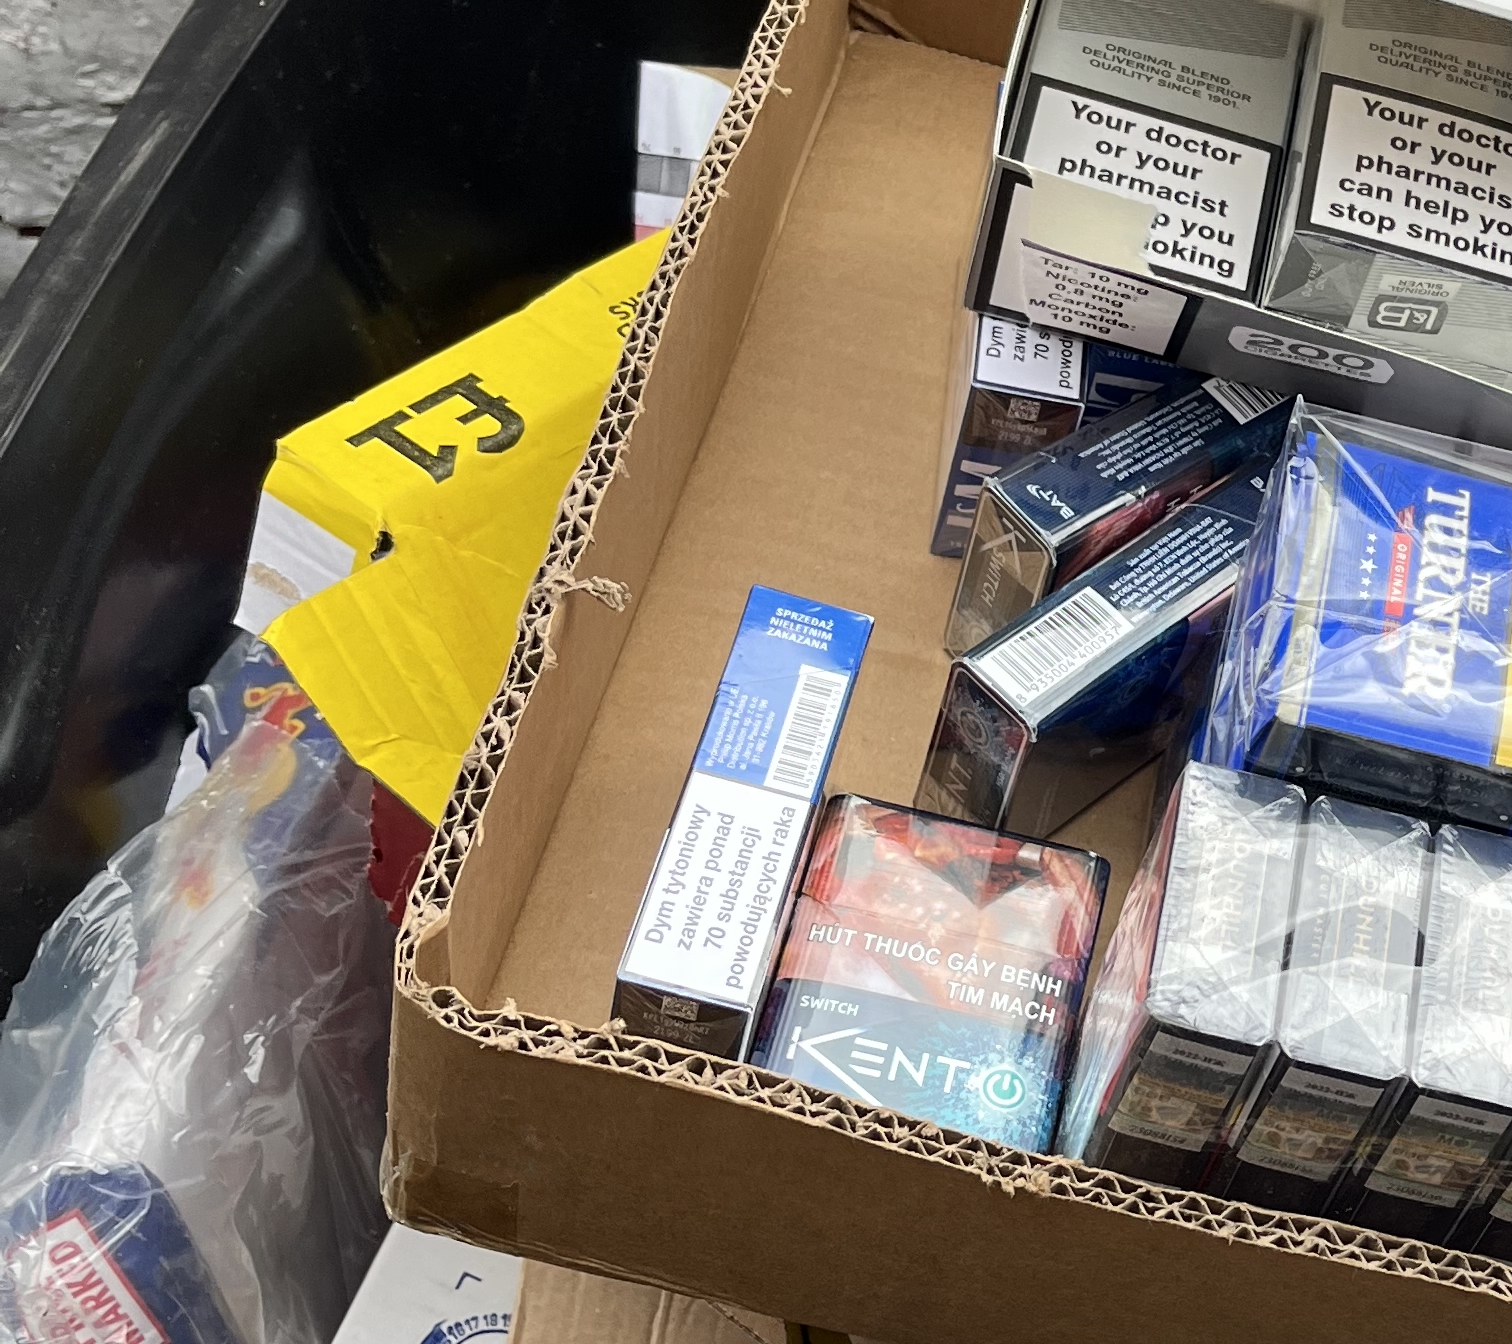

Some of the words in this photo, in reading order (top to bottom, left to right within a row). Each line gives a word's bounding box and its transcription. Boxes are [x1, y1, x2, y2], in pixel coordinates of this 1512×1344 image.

[1106, 43, 1177, 70] ORIGINAL
[1369, 43, 1459, 74] DELIVERING
[1392, 39, 1462, 65] ORIGINAL
[1082, 46, 1172, 78] DELIVERING
[1176, 73, 1252, 102] SUPERIOR
[1089, 59, 1154, 83] QUALITY
[1157, 78, 1201, 99] SINCE
[1377, 55, 1442, 78] QUALITY
[1446, 74, 1489, 93] SINCE
[1362, 97, 1428, 130] Your
[1071, 100, 1136, 134] Your
[1146, 126, 1242, 166] doctor
[1095, 140, 1127, 158] or
[1135, 151, 1203, 181] your
[1390, 136, 1422, 154] or
[1430, 145, 1496, 177] your
[1058, 156, 1229, 217] pharmacist
[1338, 177, 1392, 202] can
[1404, 190, 1469, 225] help
[1181, 219, 1235, 247] you
[1328, 202, 1396, 234] stop
[1046, 270, 1138, 303] Nicotine:
[1055, 283, 1084, 296] 0.8
[1092, 294, 1124, 308] mg
[1088, 271, 1111, 283] 10
[1116, 281, 1149, 295] mg
[1392, 285, 1450, 298] ORIGINAL
[1398, 279, 1444, 289] SILVER
[1029, 298, 1136, 331] Monoxide:
[1049, 293, 1124, 317] Carbon
[1376, 301, 1439, 330] L&B
[1051, 313, 1073, 323] 10
[1079, 320, 1111, 334] mg
[986, 325, 1005, 358] Dym
[1034, 343, 1049, 360] 70
[1245, 333, 1375, 370] 200
[344, 372, 526, 484] £1
[1039, 490, 1075, 519] BAT
[981, 547, 1010, 611] SWITCH
[1390, 543, 1407, 603] ORIGINAL
[1402, 487, 1470, 701] TURNER
[1469, 572, 1491, 616] THE
[767, 627, 828, 651] ZAKAZANA
[770, 617, 833, 641] NIELETNIM
[1030, 660, 1075, 693] 935004
[1078, 626, 1120, 662] 400957
[644, 900, 675, 944] Dym
[662, 803, 711, 895] tytoniowy
[678, 875, 714, 951] zawiera
[705, 811, 735, 872] ponad
[703, 927, 726, 949] 70
[717, 825, 761, 923] substancji
[726, 851, 782, 990] powodujących
[772, 806, 796, 846] raka
[808, 921, 858, 946] HÚT
[947, 950, 996, 978] GÂY
[1000, 964, 1063, 997] BỆNH
[800, 995, 859, 1016] SWITCH
[947, 981, 984, 1005] TIM
[990, 992, 1056, 1026] MẠCH
[786, 1026, 971, 1106] KENT
[464, 1316, 479, 1330] 17
[483, 1313, 498, 1327] 18
